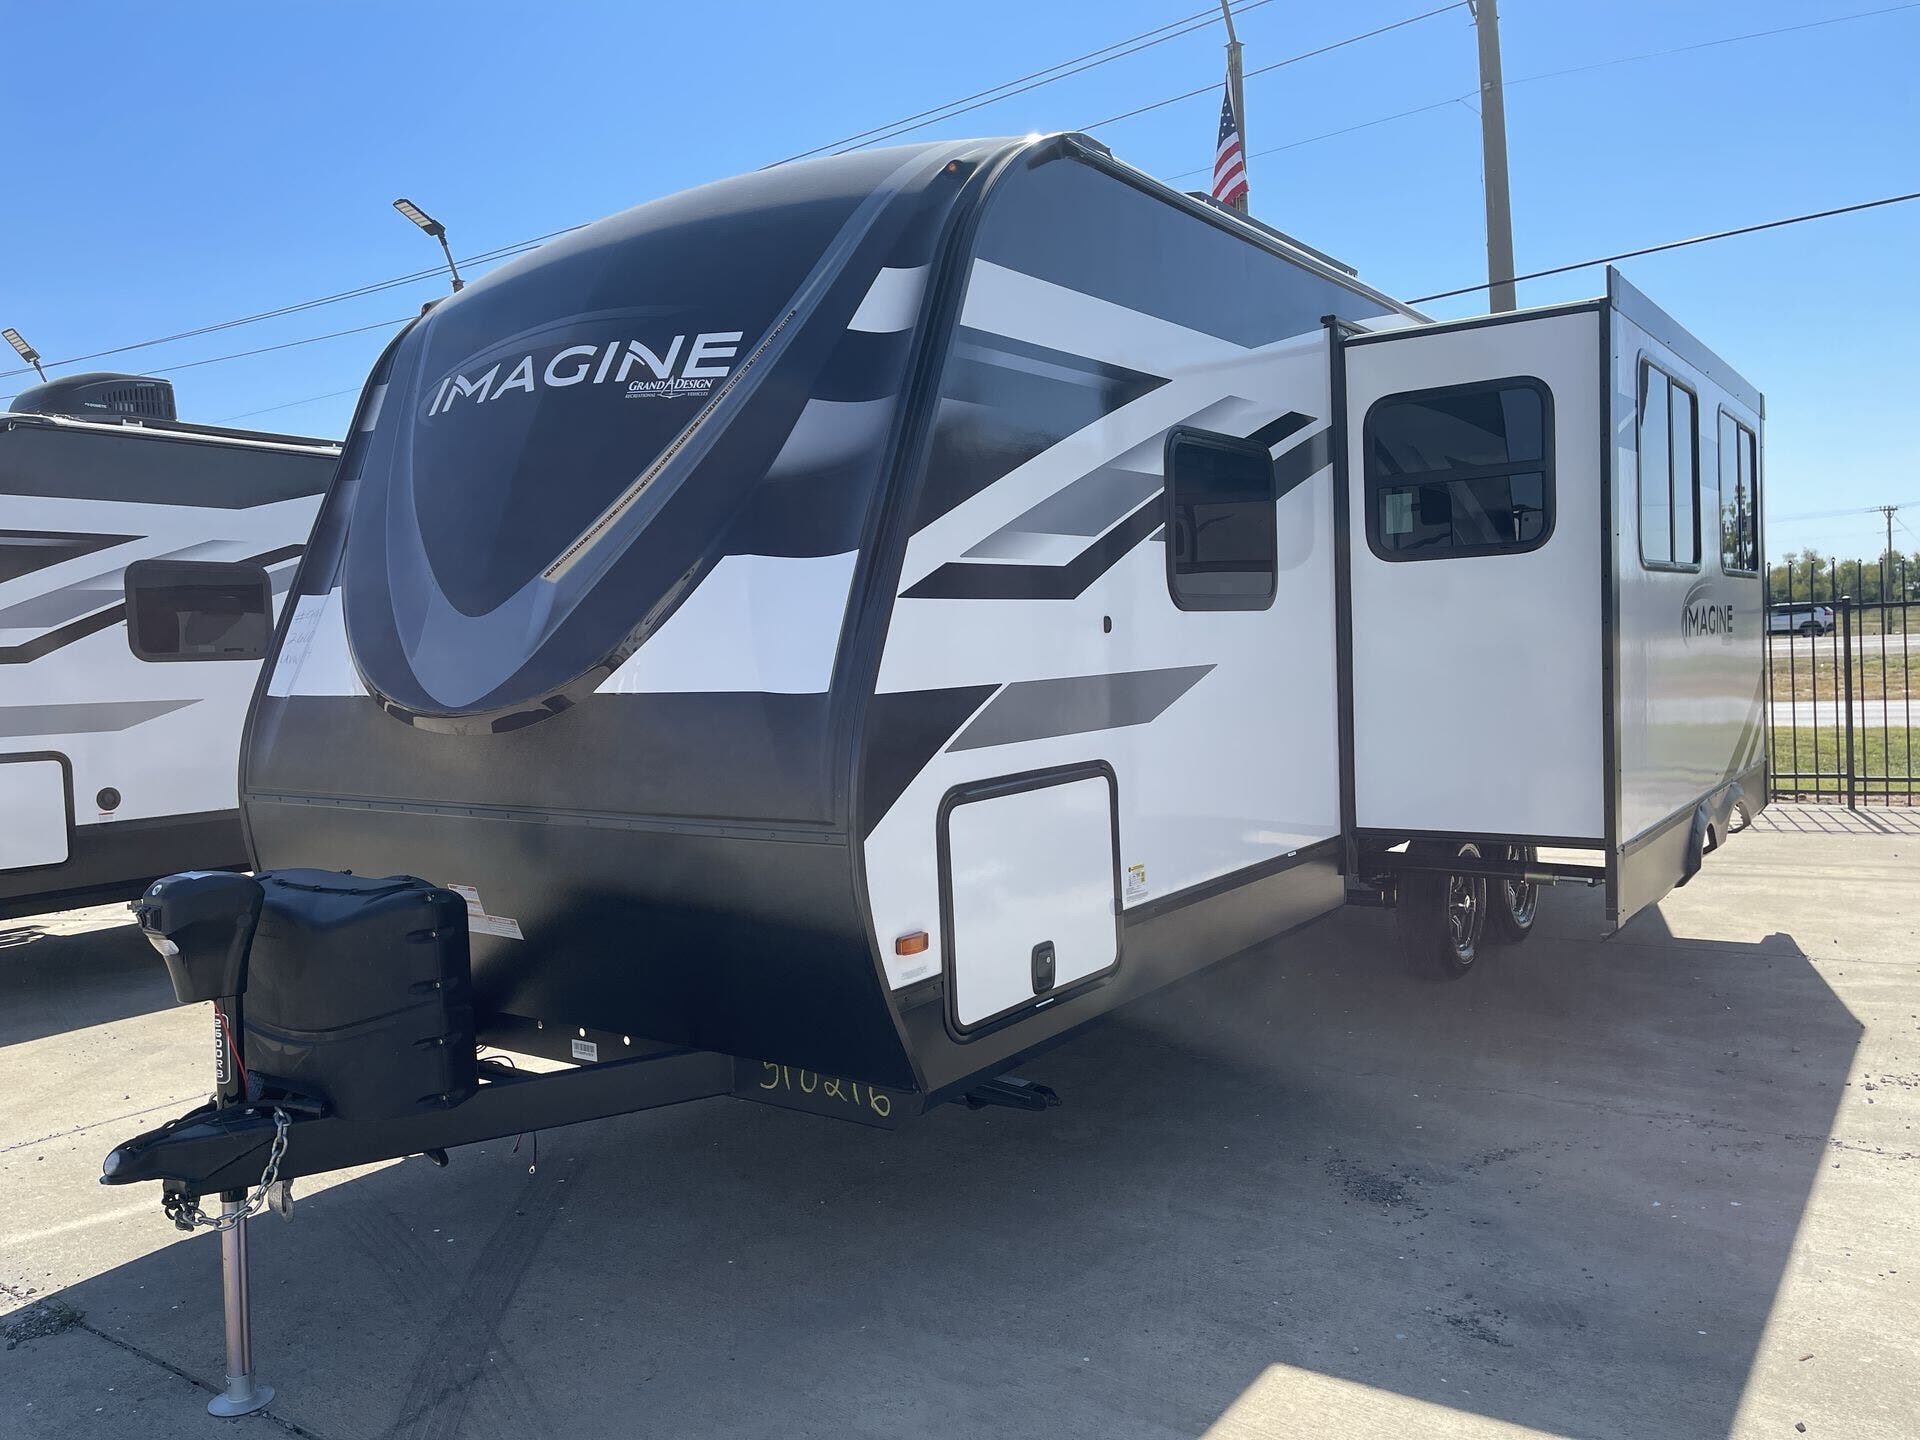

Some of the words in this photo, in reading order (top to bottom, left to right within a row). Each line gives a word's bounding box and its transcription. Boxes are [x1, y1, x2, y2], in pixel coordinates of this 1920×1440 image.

[428, 331, 744, 416] IMAGINE
[628, 380, 664, 391] GRAND
[674, 378, 714, 389] DESIGN
[1684, 605, 1733, 638] IMAGINE
